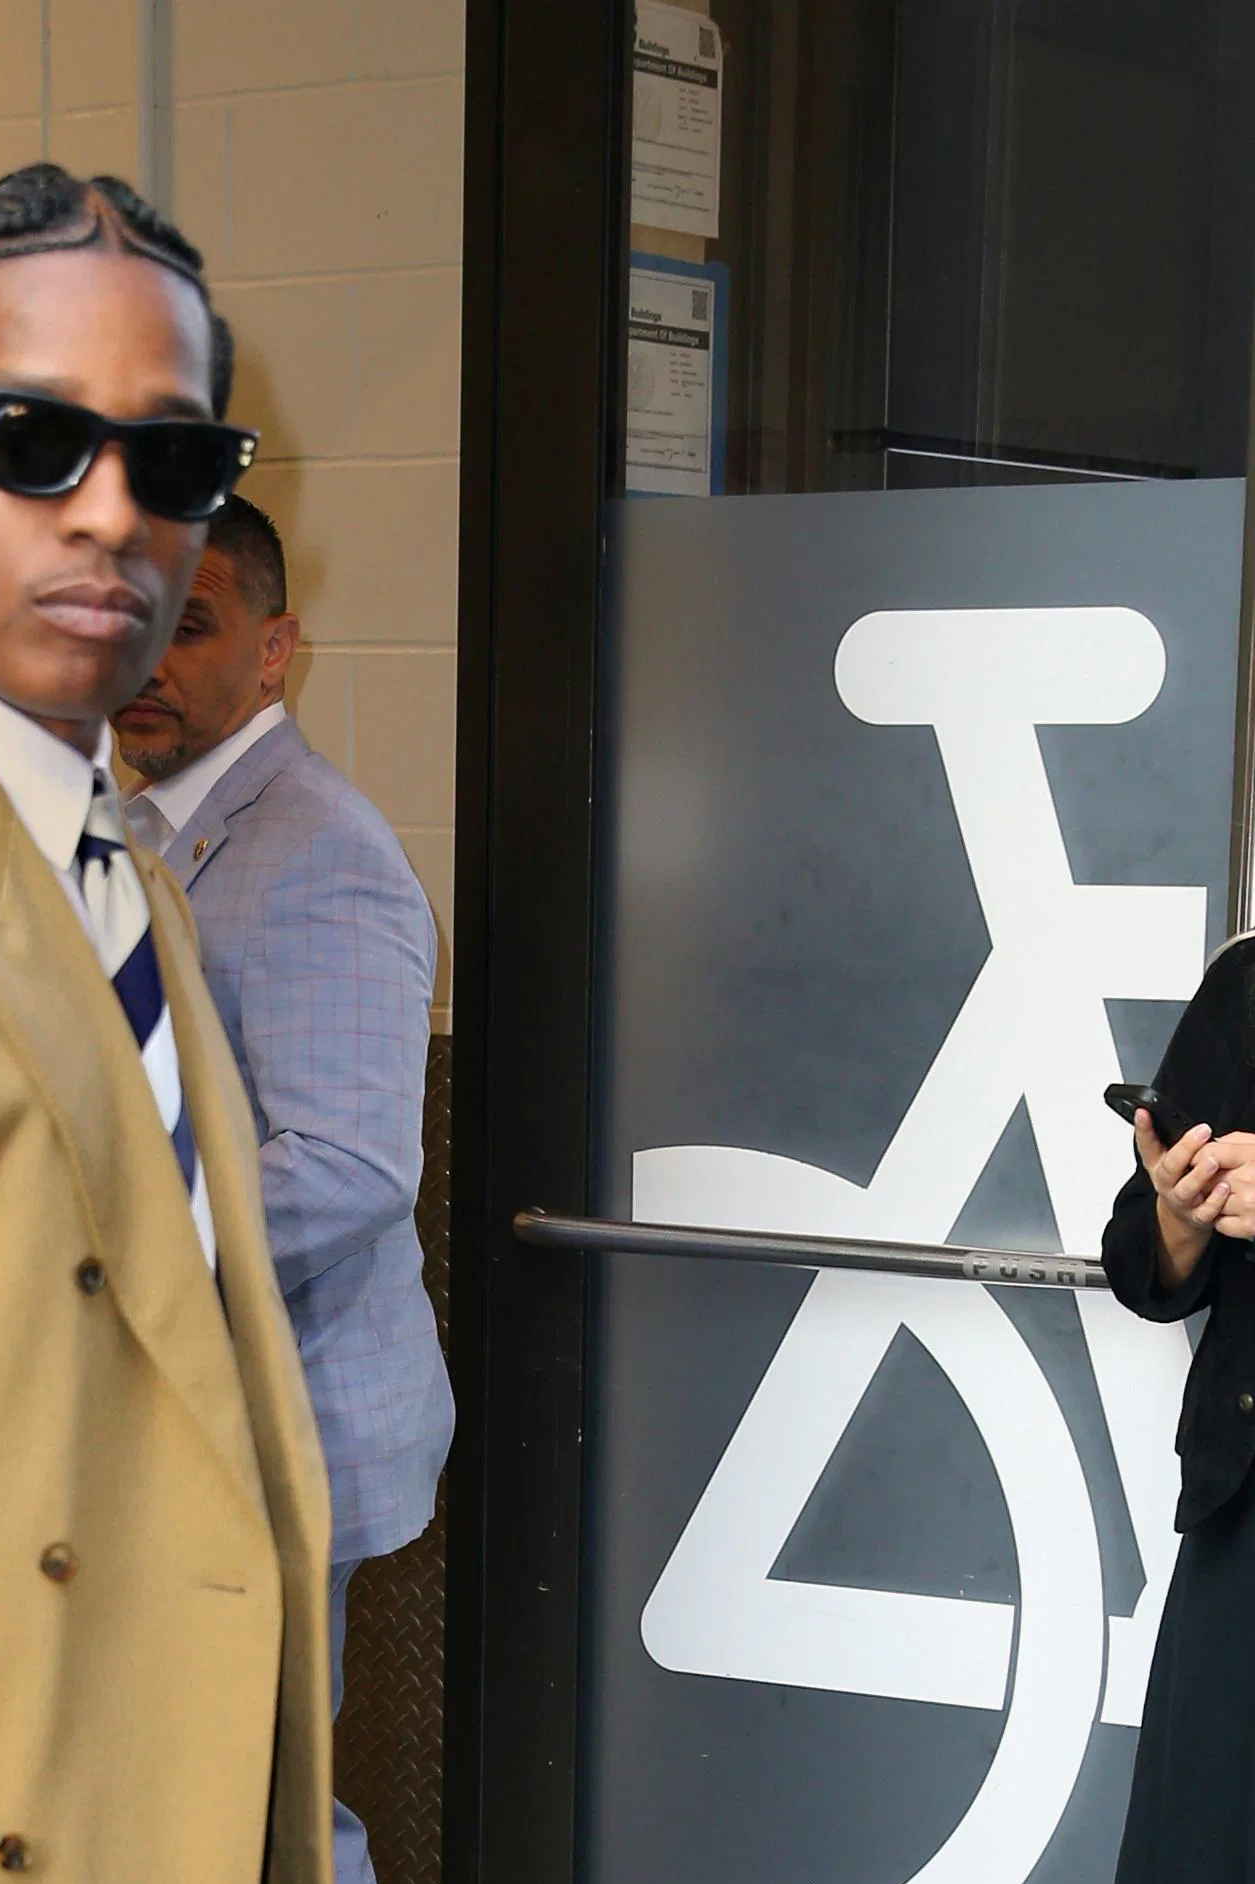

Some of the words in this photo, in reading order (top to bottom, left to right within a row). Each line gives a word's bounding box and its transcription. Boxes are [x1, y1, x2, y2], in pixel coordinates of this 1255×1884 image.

[631, 306, 662, 324] Buildings
[668, 330, 699, 348] Buildings
[972, 1254, 1076, 1285] PUSH
